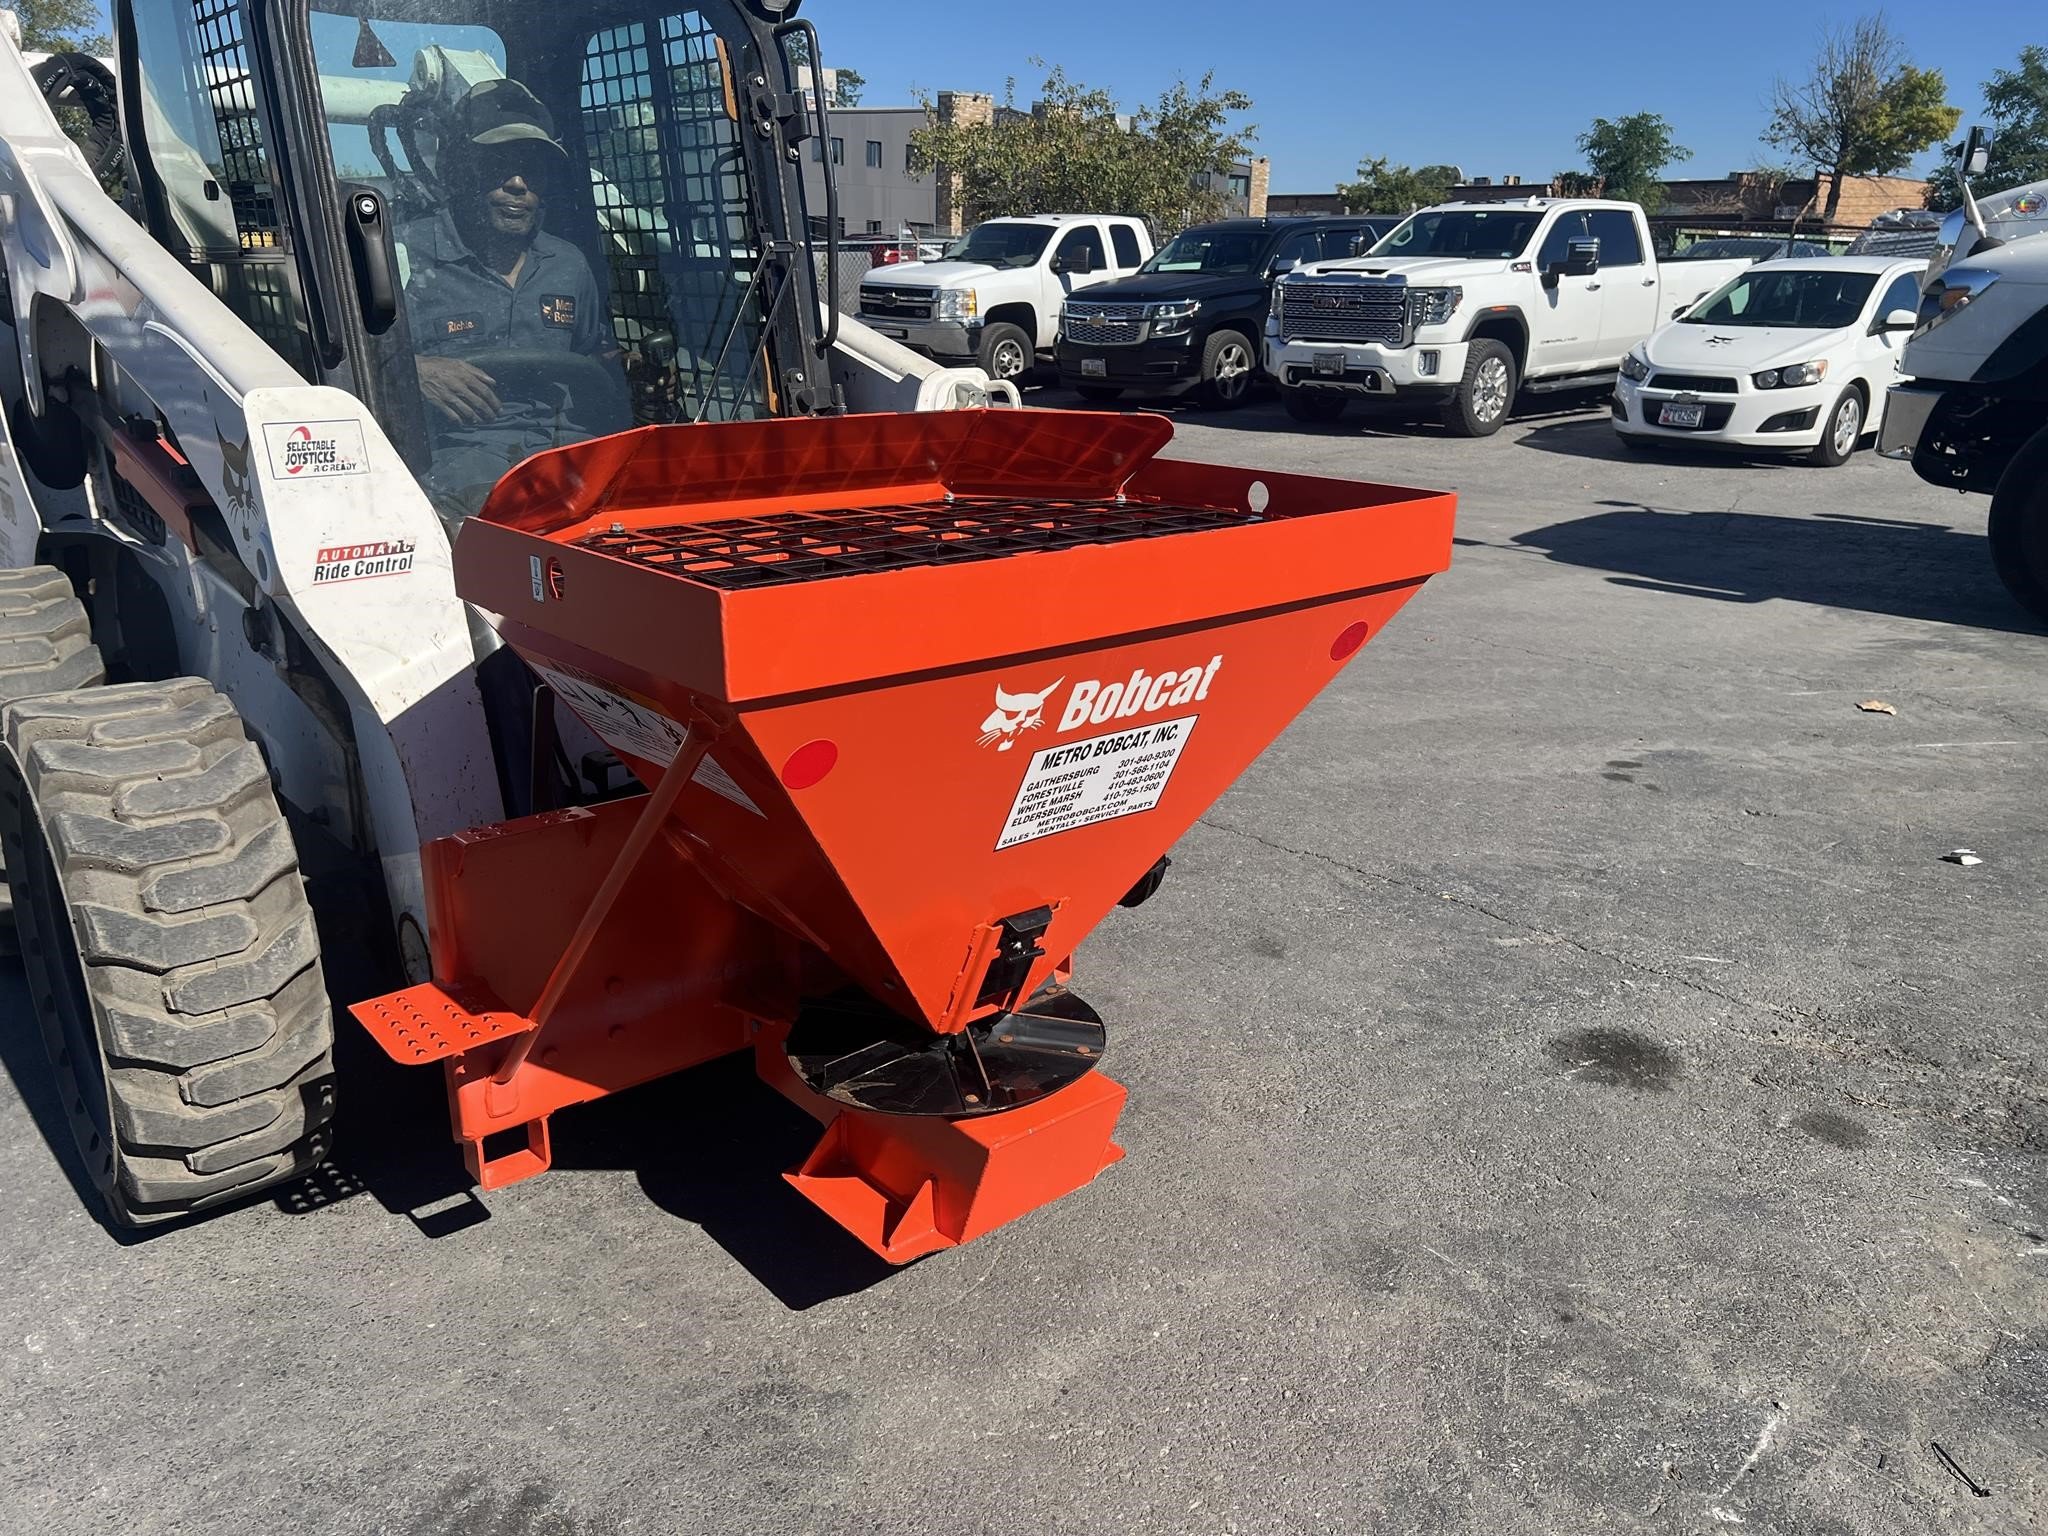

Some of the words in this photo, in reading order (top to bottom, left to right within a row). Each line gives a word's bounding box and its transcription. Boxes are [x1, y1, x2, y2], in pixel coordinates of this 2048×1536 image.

[285, 450, 336, 466] JOYSTICKS
[286, 439, 336, 452] SELECTABLE
[330, 462, 357, 472] READY
[313, 563, 350, 582] Ride
[354, 554, 414, 576] Control
[1056, 654, 1223, 733] Bobcat
[1040, 743, 1093, 771] METRO
[1093, 731, 1150, 758] BOBCAT,
[1151, 723, 1179, 745] INC.
[1026, 765, 1100, 792] GAITHERSBURG
[1117, 748, 1176, 769] 301-840-9300
[1011, 803, 1074, 828] ELDERSBURG
[1102, 782, 1161, 802] 410-795-1500
[1016, 798, 1050, 816] WHITE
[1050, 790, 1083, 808] MARSH
[1021, 780, 1085, 805] FORESTVILLE
[1001, 832, 1030, 846] SALES
[1037, 819, 1077, 836] RENTALS
[1083, 810, 1120, 824] SERVICE
[1124, 800, 1154, 813] PARTS
[1036, 799, 1129, 828] METROBOBCAT.COM
